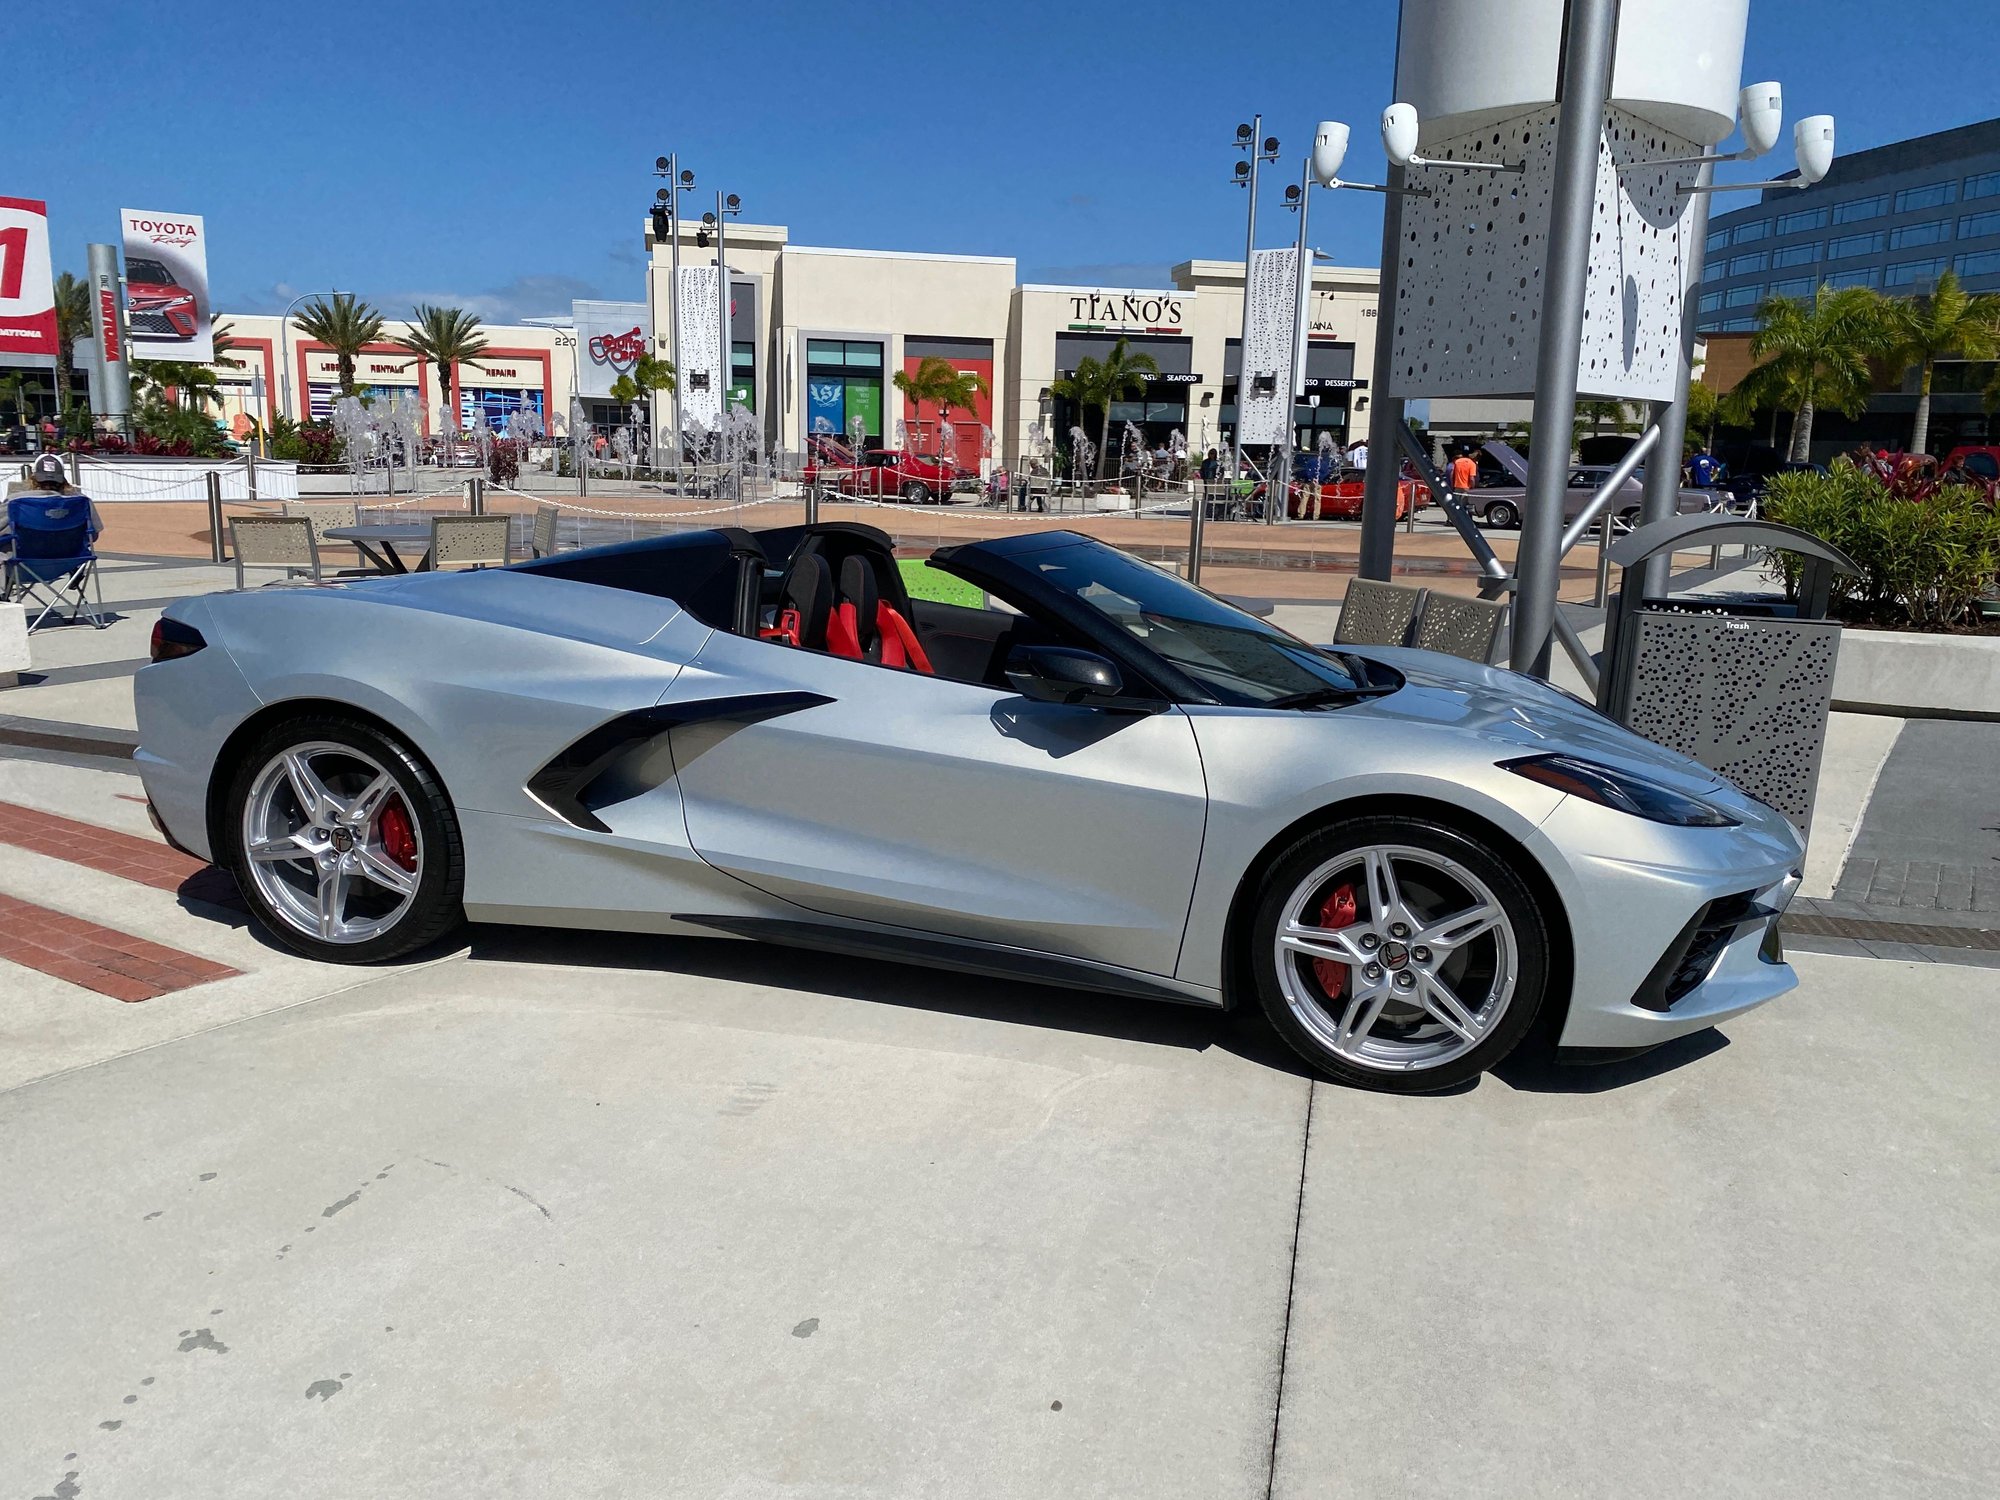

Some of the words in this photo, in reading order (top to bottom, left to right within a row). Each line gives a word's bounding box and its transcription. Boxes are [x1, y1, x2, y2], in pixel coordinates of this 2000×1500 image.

[129, 219, 197, 236] TOYOTA
[1070, 297, 1182, 324] TIANO'S
[1308, 321, 1333, 331] IANA
[554, 337, 577, 347] 220
[370, 364, 404, 374] RENTALS
[485, 368, 516, 378] REPAIRS
[1166, 374, 1197, 382] SEAFOOD
[1324, 379, 1356, 387] DESSERTS
[1726, 621, 1749, 630] Trash
